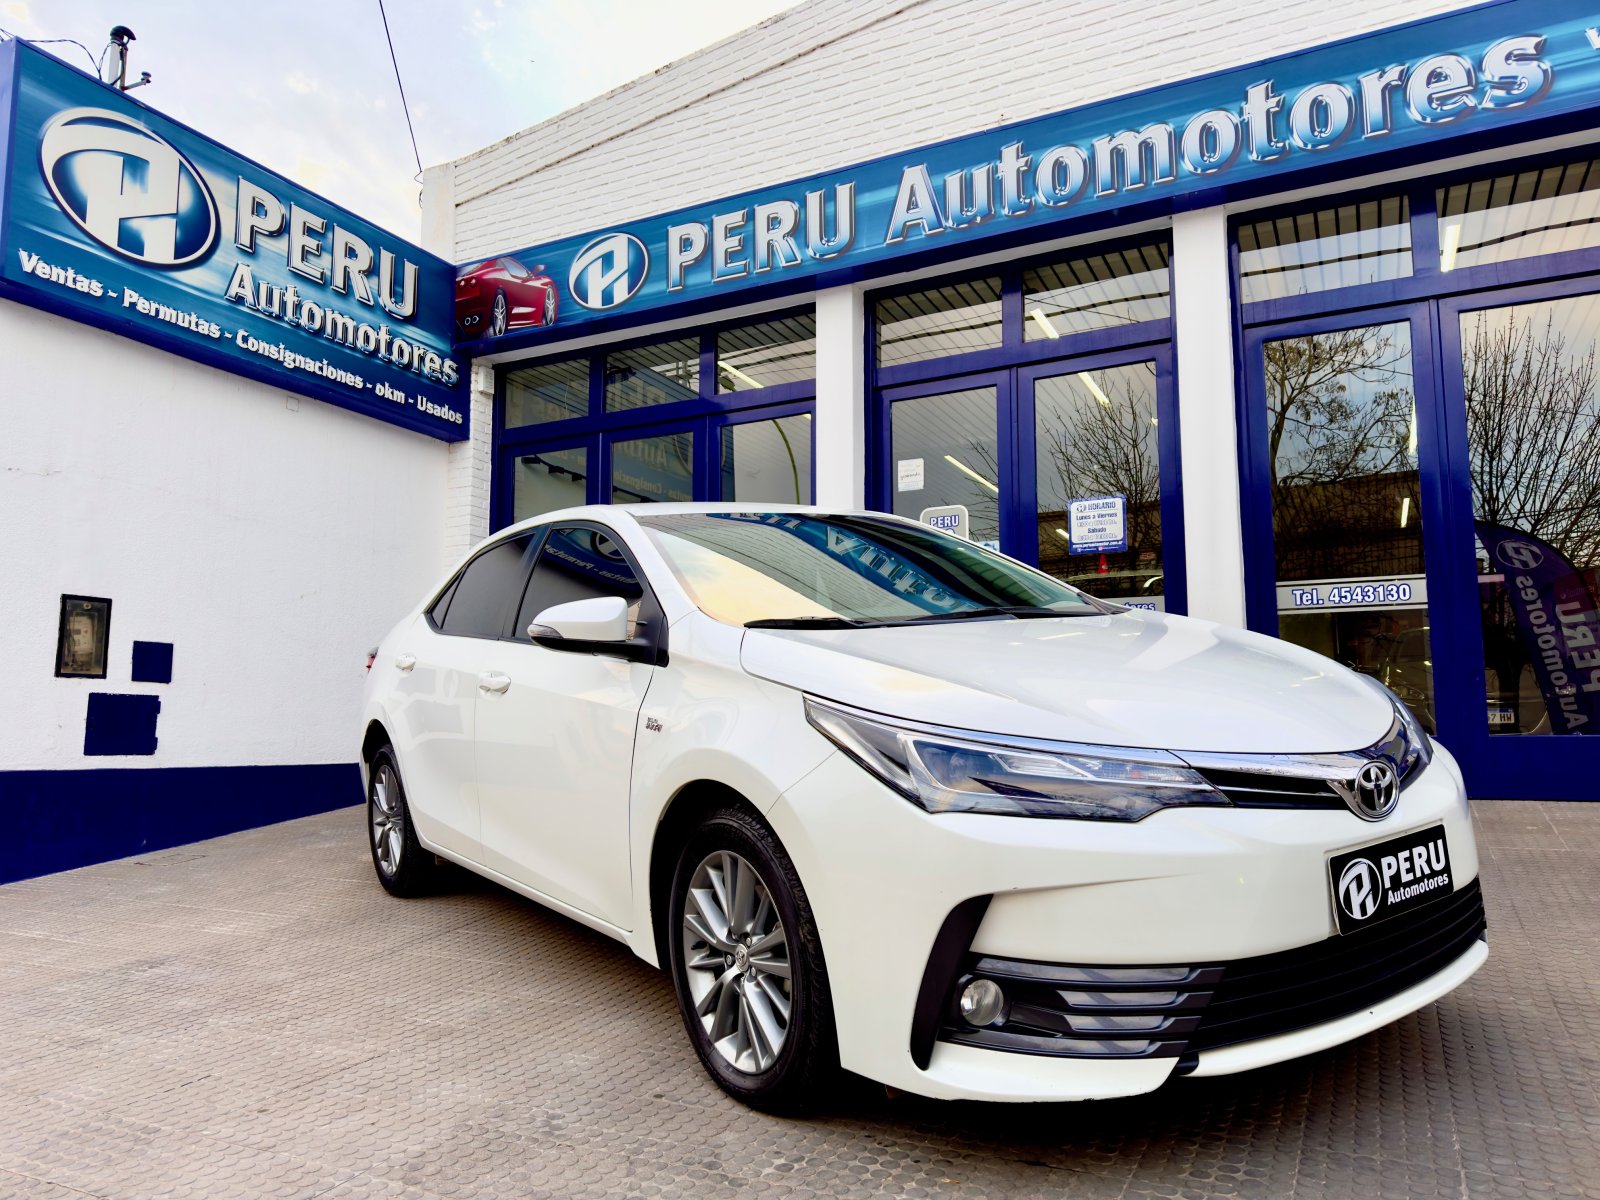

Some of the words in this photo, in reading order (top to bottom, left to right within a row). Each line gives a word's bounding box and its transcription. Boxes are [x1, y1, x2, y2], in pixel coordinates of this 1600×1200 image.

[666, 181, 856, 293] PERU
[885, 33, 1553, 247] Automotores
[234, 175, 419, 320] PERU
[19, 248, 104, 297] Ventas
[122, 286, 221, 339] Permutas
[235, 328, 364, 389] Consignaciones
[417, 394, 464, 425] Usados
[224, 261, 460, 387] Automotores
[930, 515, 960, 528] PERU
[1293, 588, 1325, 606] Tel.
[1329, 583, 1412, 604] 4543130
[1381, 839, 1446, 889] PERU
[1387, 873, 1449, 906] Automotores
